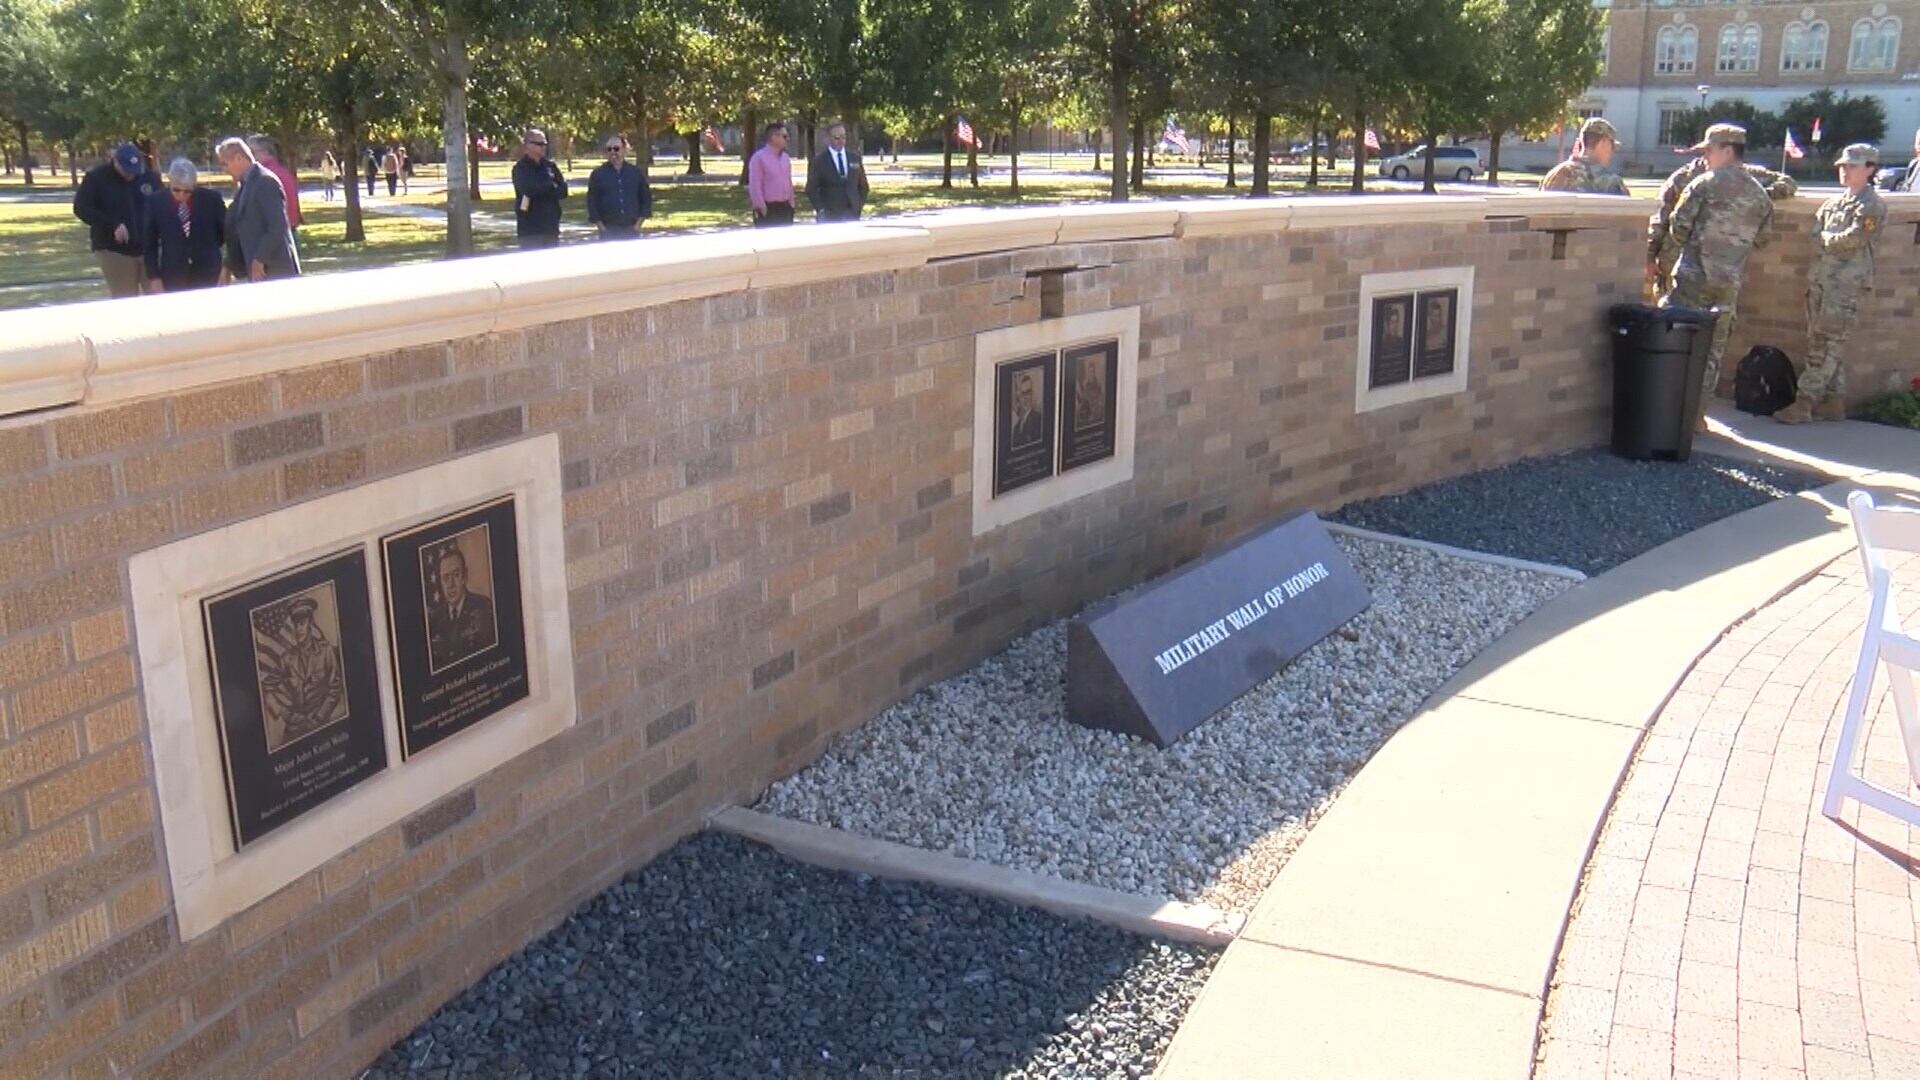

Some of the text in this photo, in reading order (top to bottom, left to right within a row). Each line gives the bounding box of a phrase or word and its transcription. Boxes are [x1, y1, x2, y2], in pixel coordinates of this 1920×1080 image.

[1154, 562, 1329, 675] MILITARY WALL OF HONOR
